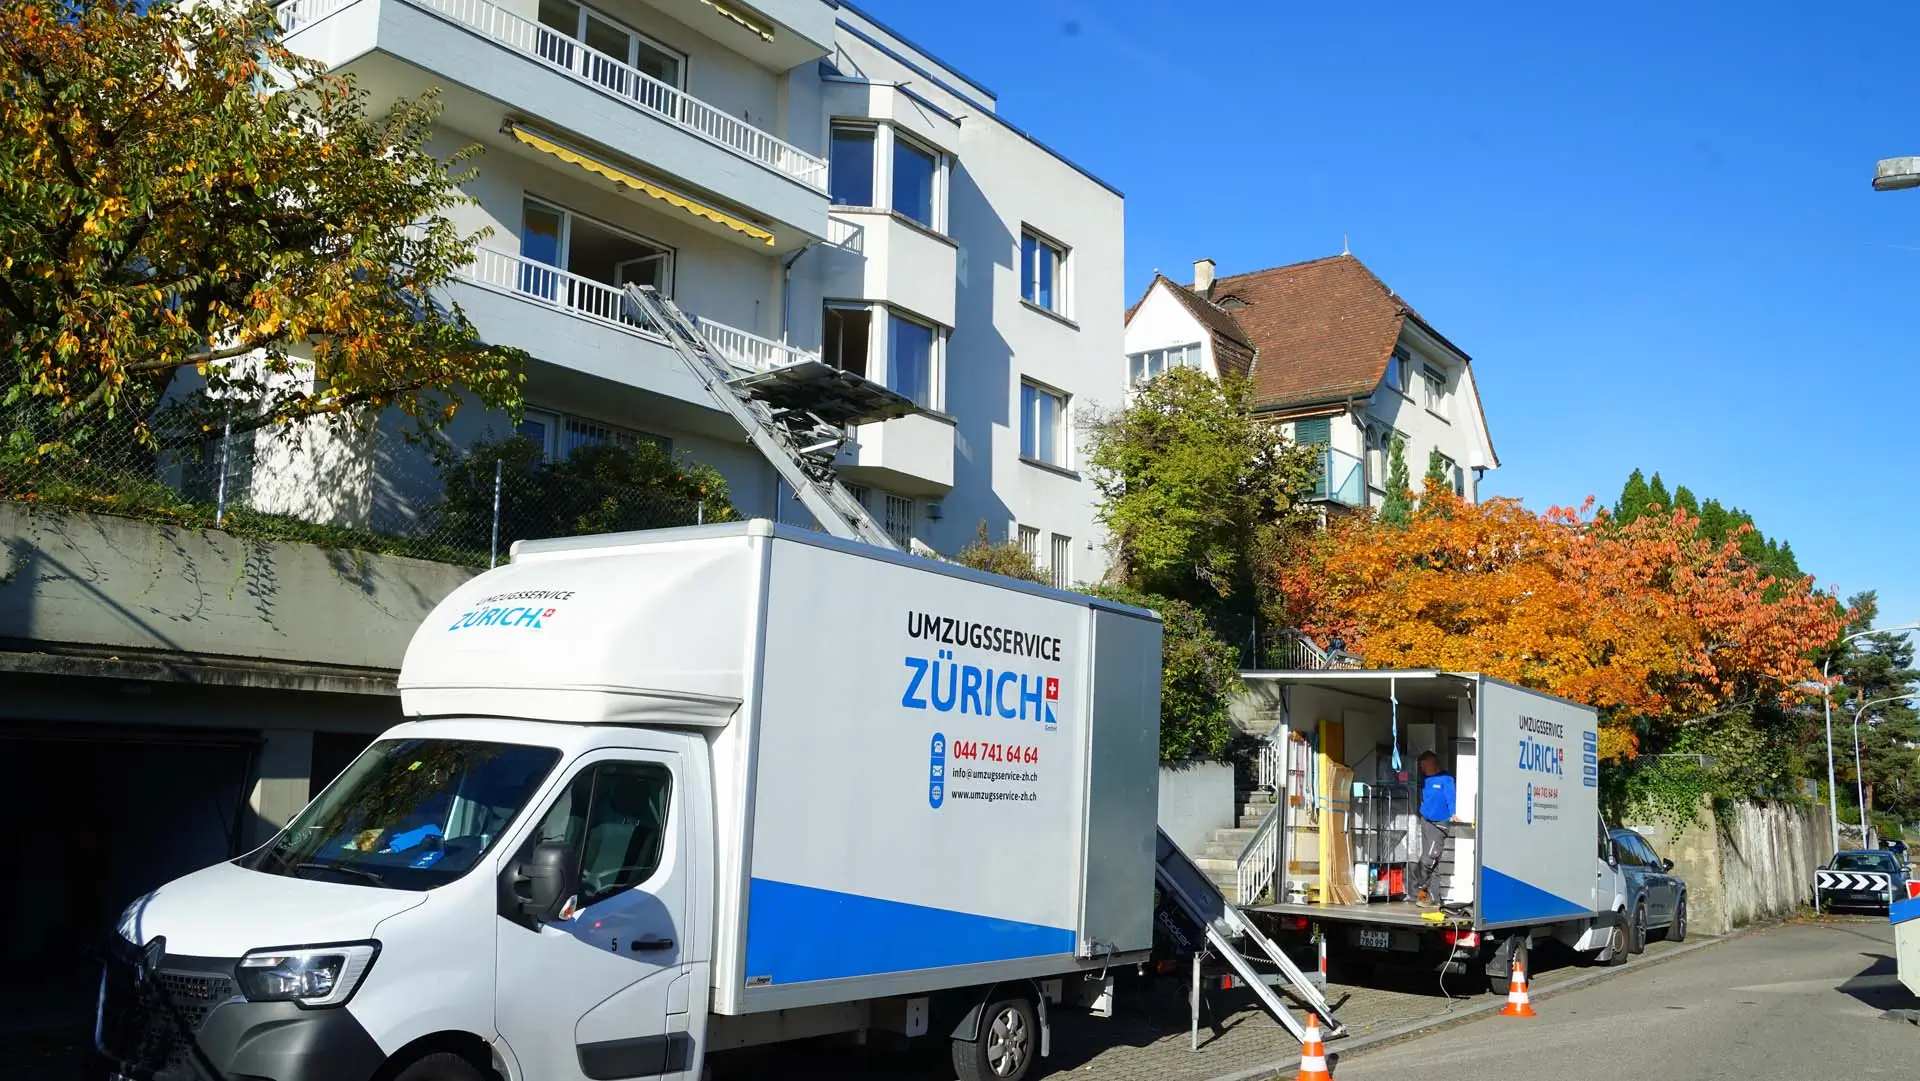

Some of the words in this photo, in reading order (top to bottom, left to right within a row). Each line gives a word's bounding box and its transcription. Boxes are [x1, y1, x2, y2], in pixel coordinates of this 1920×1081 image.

[448, 606, 543, 631] ZÜRICH
[908, 611, 1061, 661] UMZUGSSERVICE
[902, 649, 1043, 721] ZÜRICH
[1519, 714, 1563, 738] UMZUGSSERVICE
[953, 741, 977, 760] 044
[981, 743, 1003, 762] 741
[1006, 745, 1021, 763] 64
[1024, 747, 1038, 764] 64
[1519, 736, 1559, 775] ZÜRICH
[951, 790, 1037, 802] www.umzugsservice-zh.ch
[1159, 911, 1191, 946] Böcker
[612, 938, 618, 952] 5
